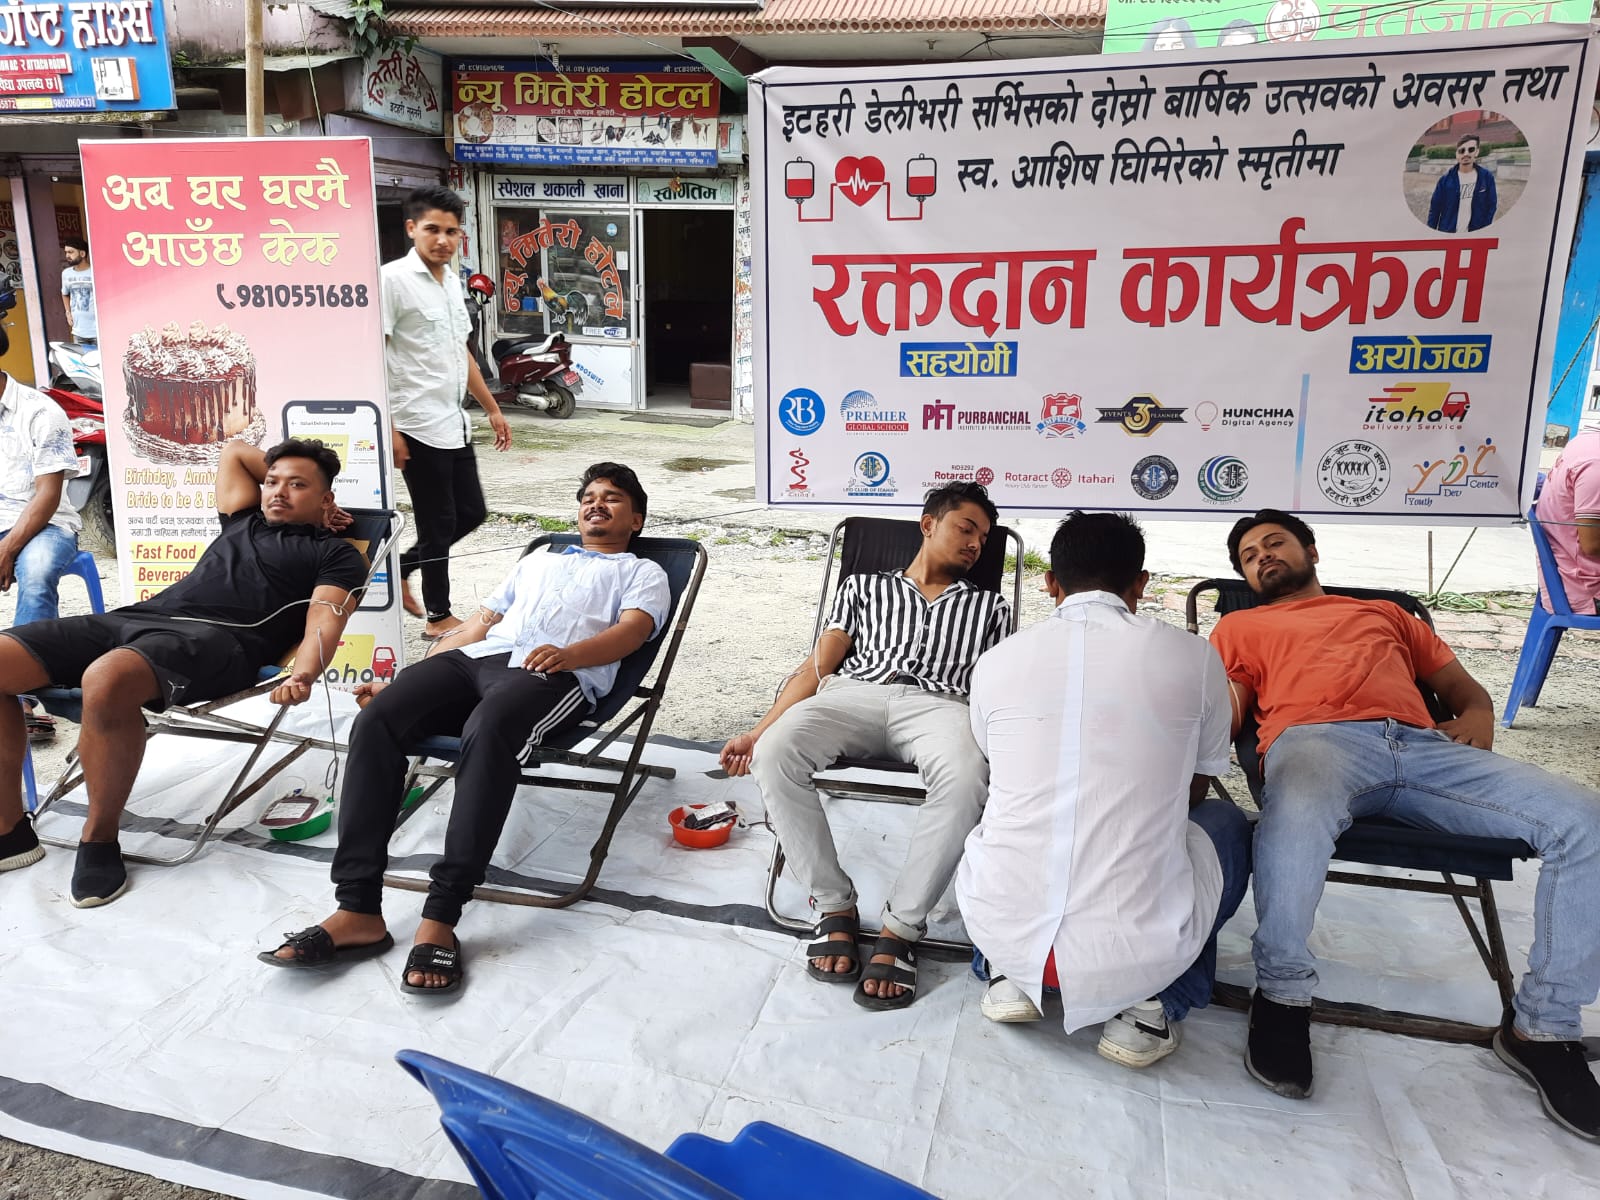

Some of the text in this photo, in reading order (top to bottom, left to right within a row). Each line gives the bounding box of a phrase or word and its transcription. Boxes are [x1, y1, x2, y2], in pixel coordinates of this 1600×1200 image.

[68, 1, 155, 48] हाउस
[457, 73, 713, 112] न्यू मितेरी होटल
[782, 88, 856, 143] इटहरी
[865, 83, 963, 132] डेलीभरी
[1092, 75, 1156, 129] दोस्रो
[1164, 69, 1257, 118] बार्षिक
[1266, 62, 1385, 115] उत्सवको
[1393, 70, 1495, 109] अवसर
[1503, 65, 1569, 104] तथा
[958, 129, 1345, 192] स्व. आशिष घिमिरेको स्मृतीमा
[102, 157, 351, 211] अब घर घरमै
[498, 178, 624, 199] स्पेशल थकाली खाना
[122, 217, 340, 267] आउँछ केक
[509, 217, 582, 267] मितेरी
[584, 235, 627, 320] होटल
[811, 217, 1499, 339] रक्तदान कार्यक्रम
[236, 283, 369, 308] 9810551688
[905, 342, 1013, 377] सहयोगी
[846, 411, 908, 422] PREMIER
[957, 411, 1032, 425] PURBANCHAL
[1222, 407, 1295, 418] HUNCHHA
[847, 423, 907, 431] GLOBAL SCHOOL
[1221, 418, 1295, 427] Digital Agency
[1362, 423, 1463, 431] Delivery Service
[125, 467, 217, 489] Birthday, Anniv
[335, 477, 359, 485] Delivery
[934, 471, 974, 480] Rotaract
[1005, 472, 1049, 482] Rotaract
[1078, 473, 1115, 484] Itahari
[127, 491, 217, 508] Bride to be & B
[1408, 479, 1500, 508] Youth Dev Center
[136, 544, 197, 559] Fast Food
[138, 567, 190, 582] Bevera
